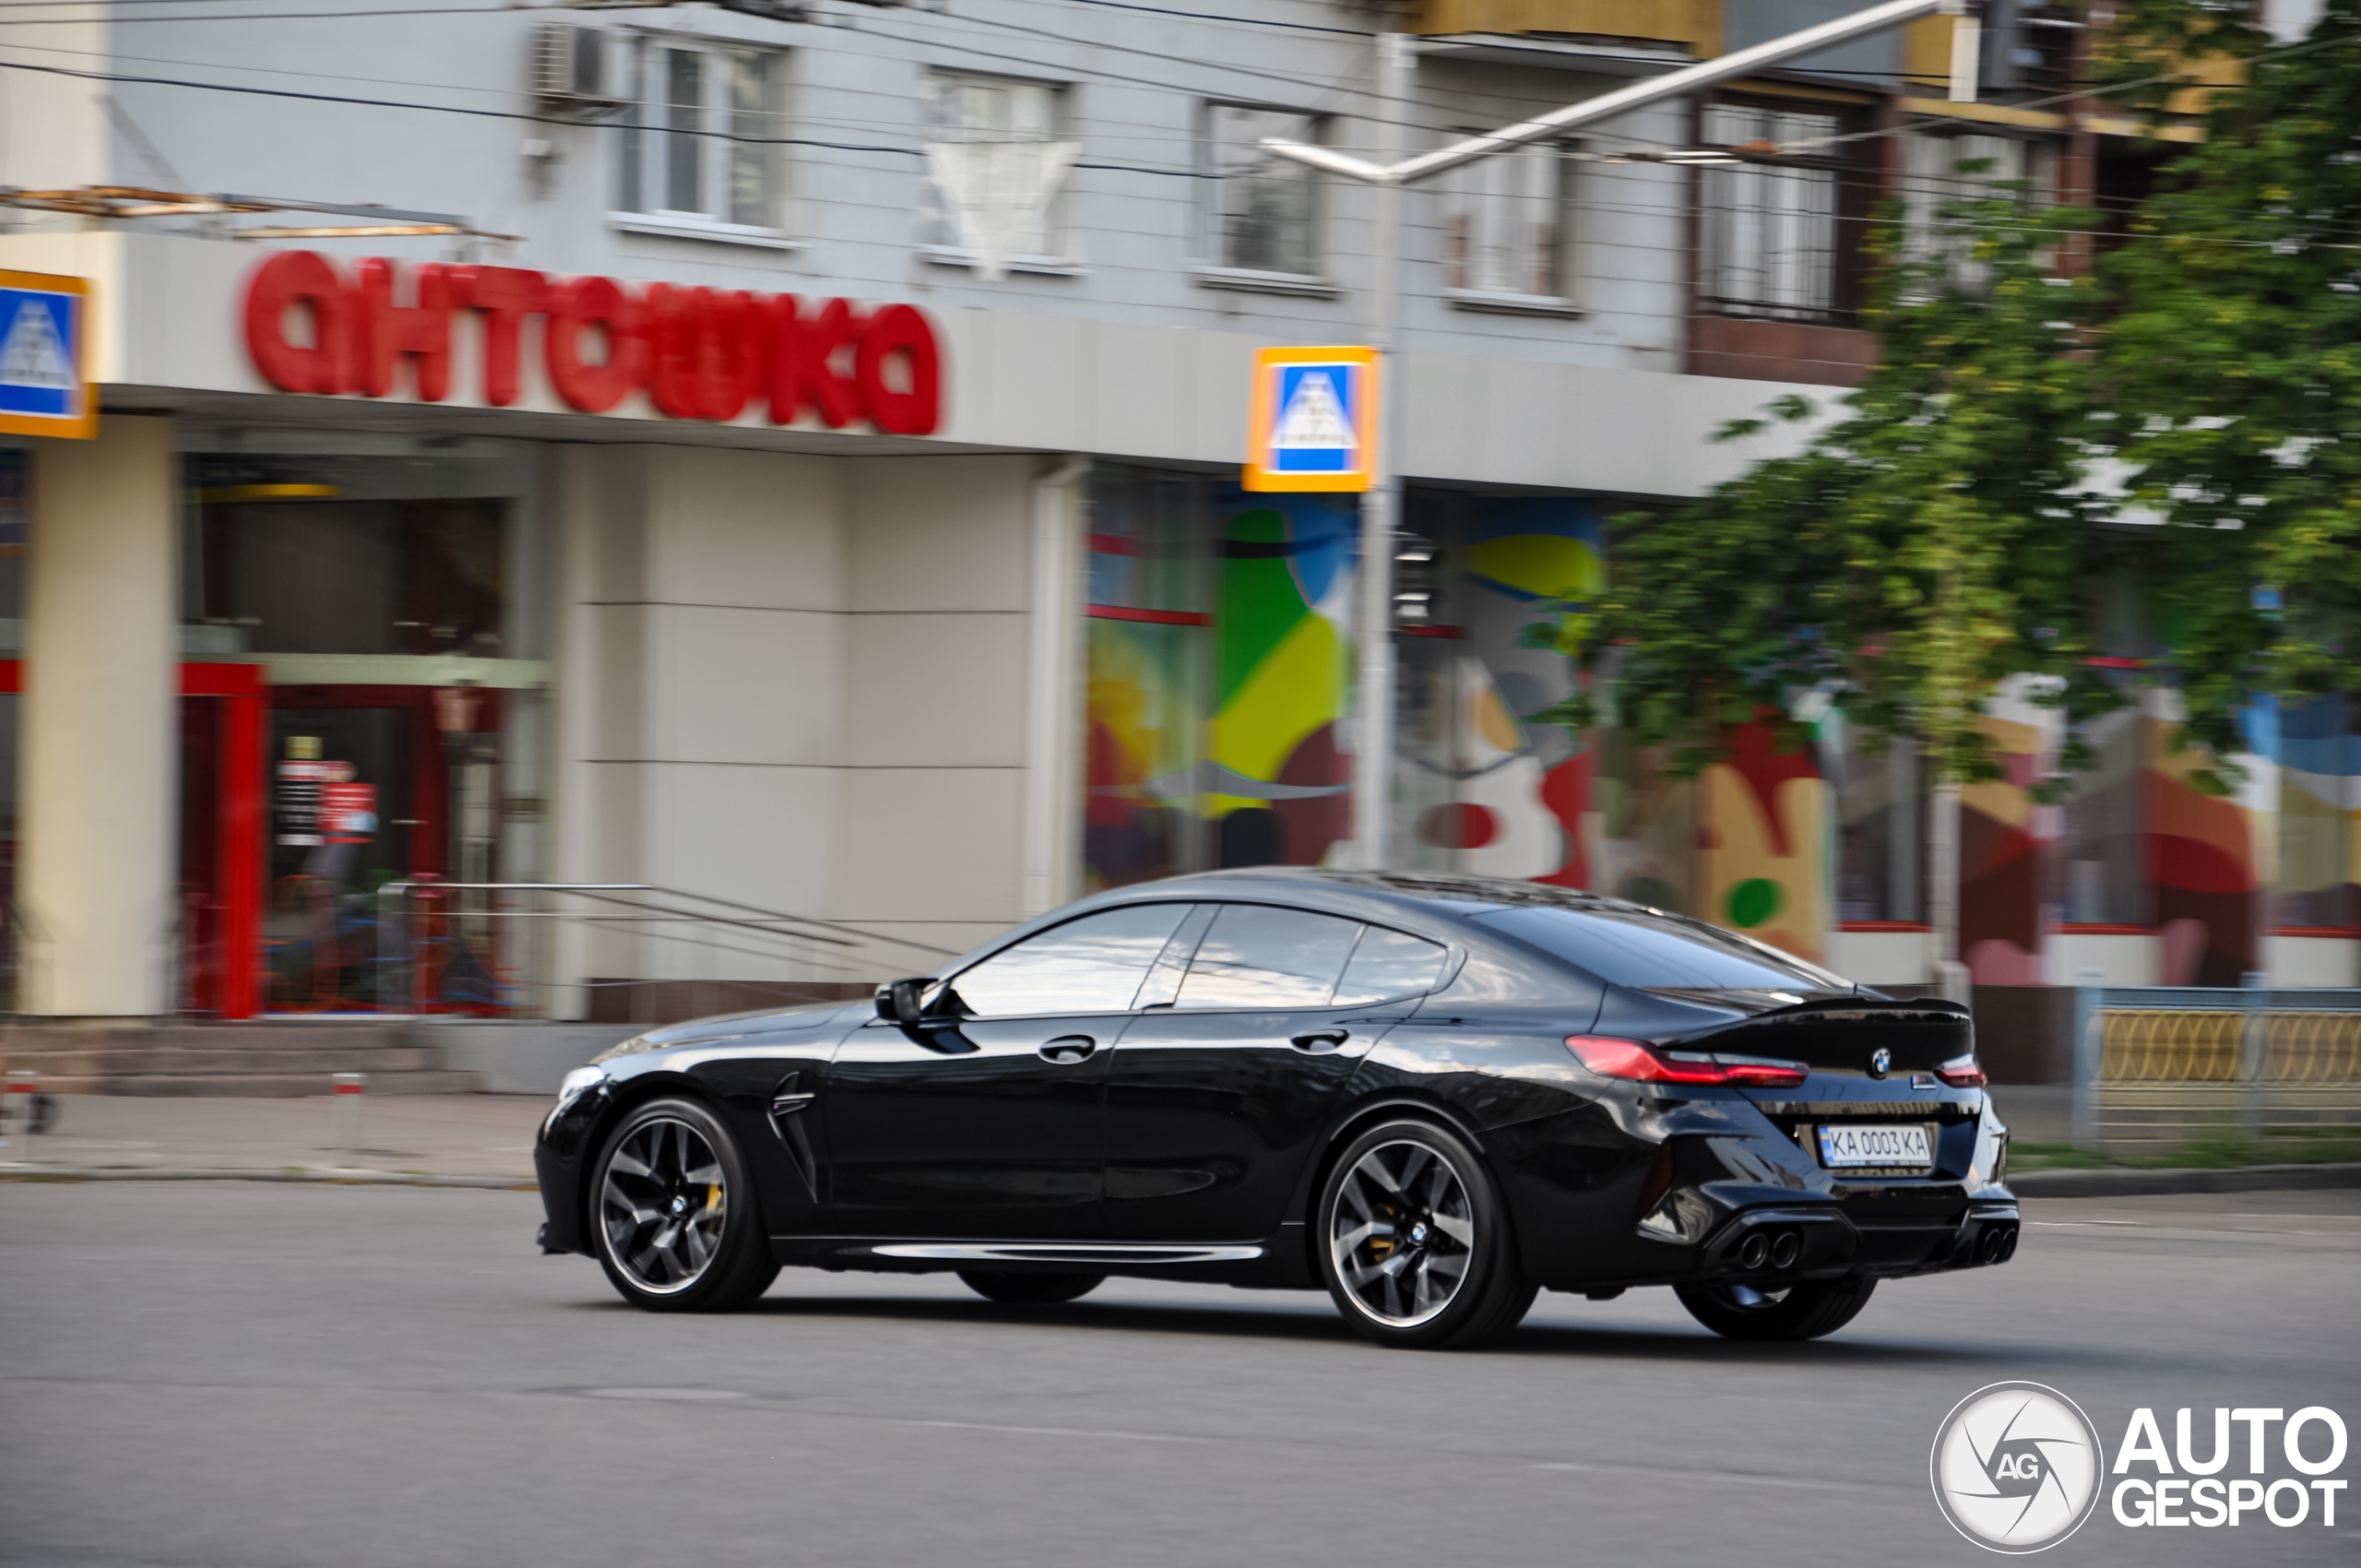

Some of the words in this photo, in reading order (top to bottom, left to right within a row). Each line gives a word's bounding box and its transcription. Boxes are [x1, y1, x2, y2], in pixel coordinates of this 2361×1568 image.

[1831, 1131, 1859, 1156] KA
[1861, 1131, 1900, 1156] 0003
[1901, 1131, 1928, 1156] KA
